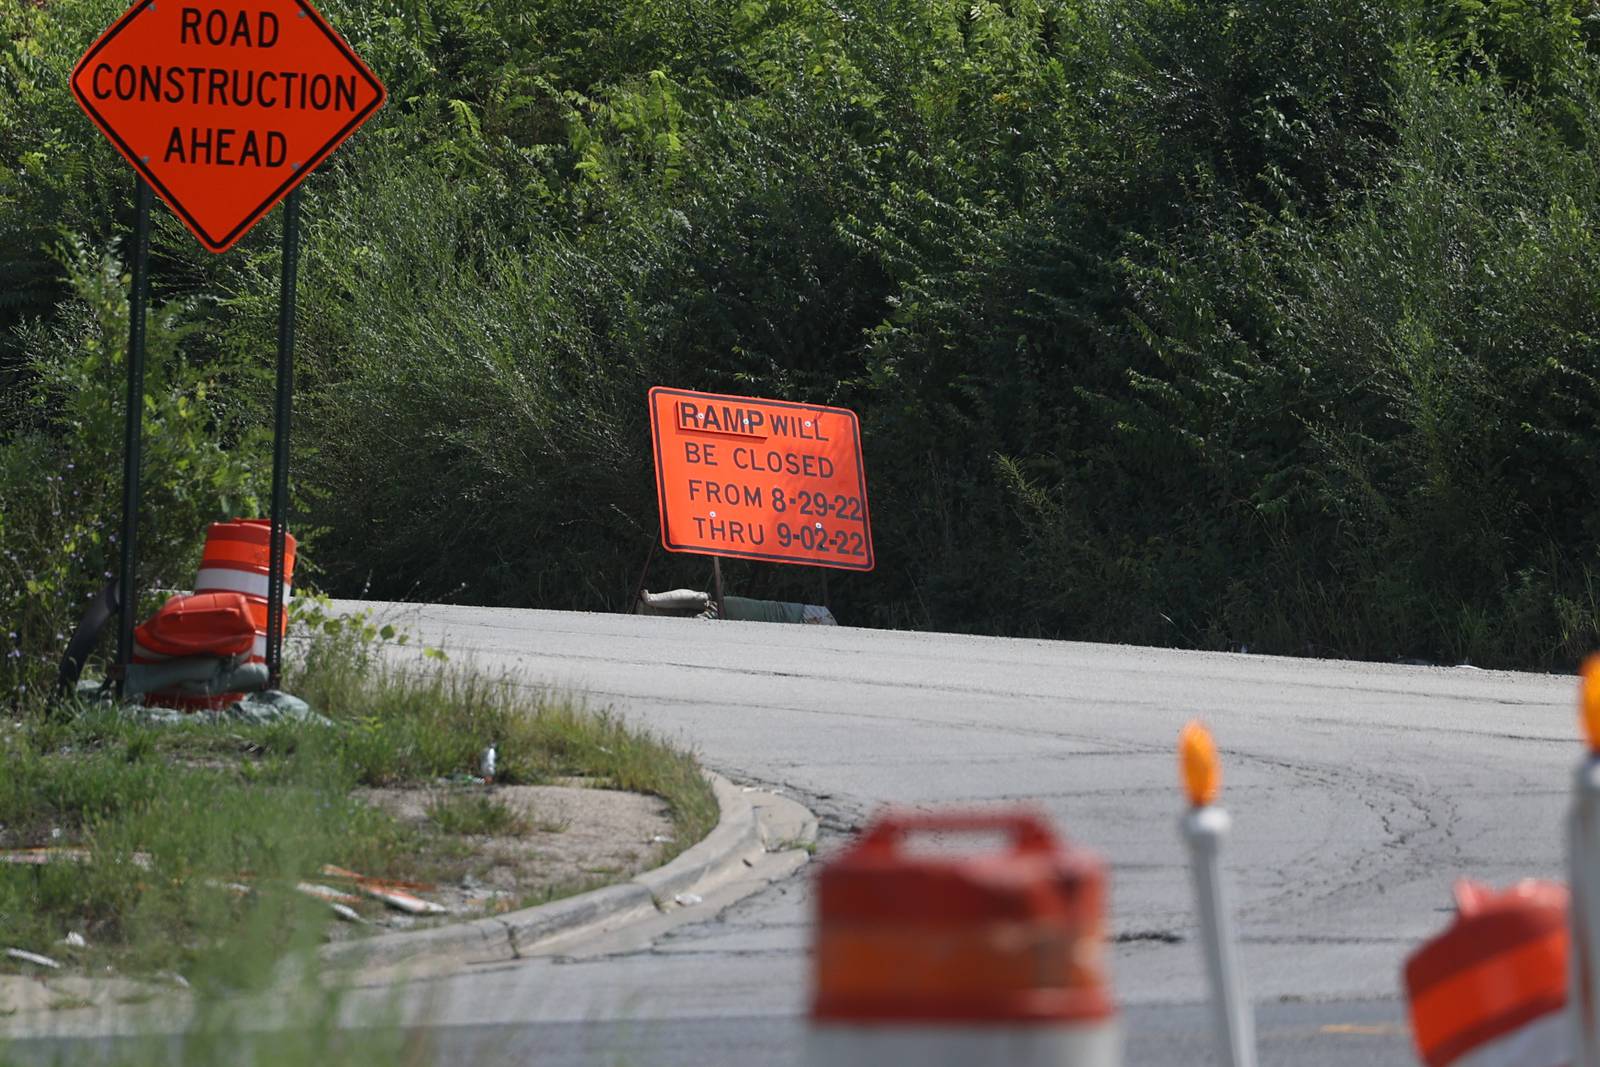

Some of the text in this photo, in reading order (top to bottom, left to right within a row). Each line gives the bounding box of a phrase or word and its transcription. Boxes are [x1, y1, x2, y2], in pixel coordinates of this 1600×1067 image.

[180, 7, 279, 48] ROAD
[92, 63, 357, 112] CONSTRUCTION
[163, 127, 288, 168] AHEAD
[680, 401, 830, 442] RAMP WILL
[684, 442, 834, 478] BE CLOSED
[688, 479, 864, 521] FROM 8-29-22
[693, 517, 865, 556] THRU 9-02-22
